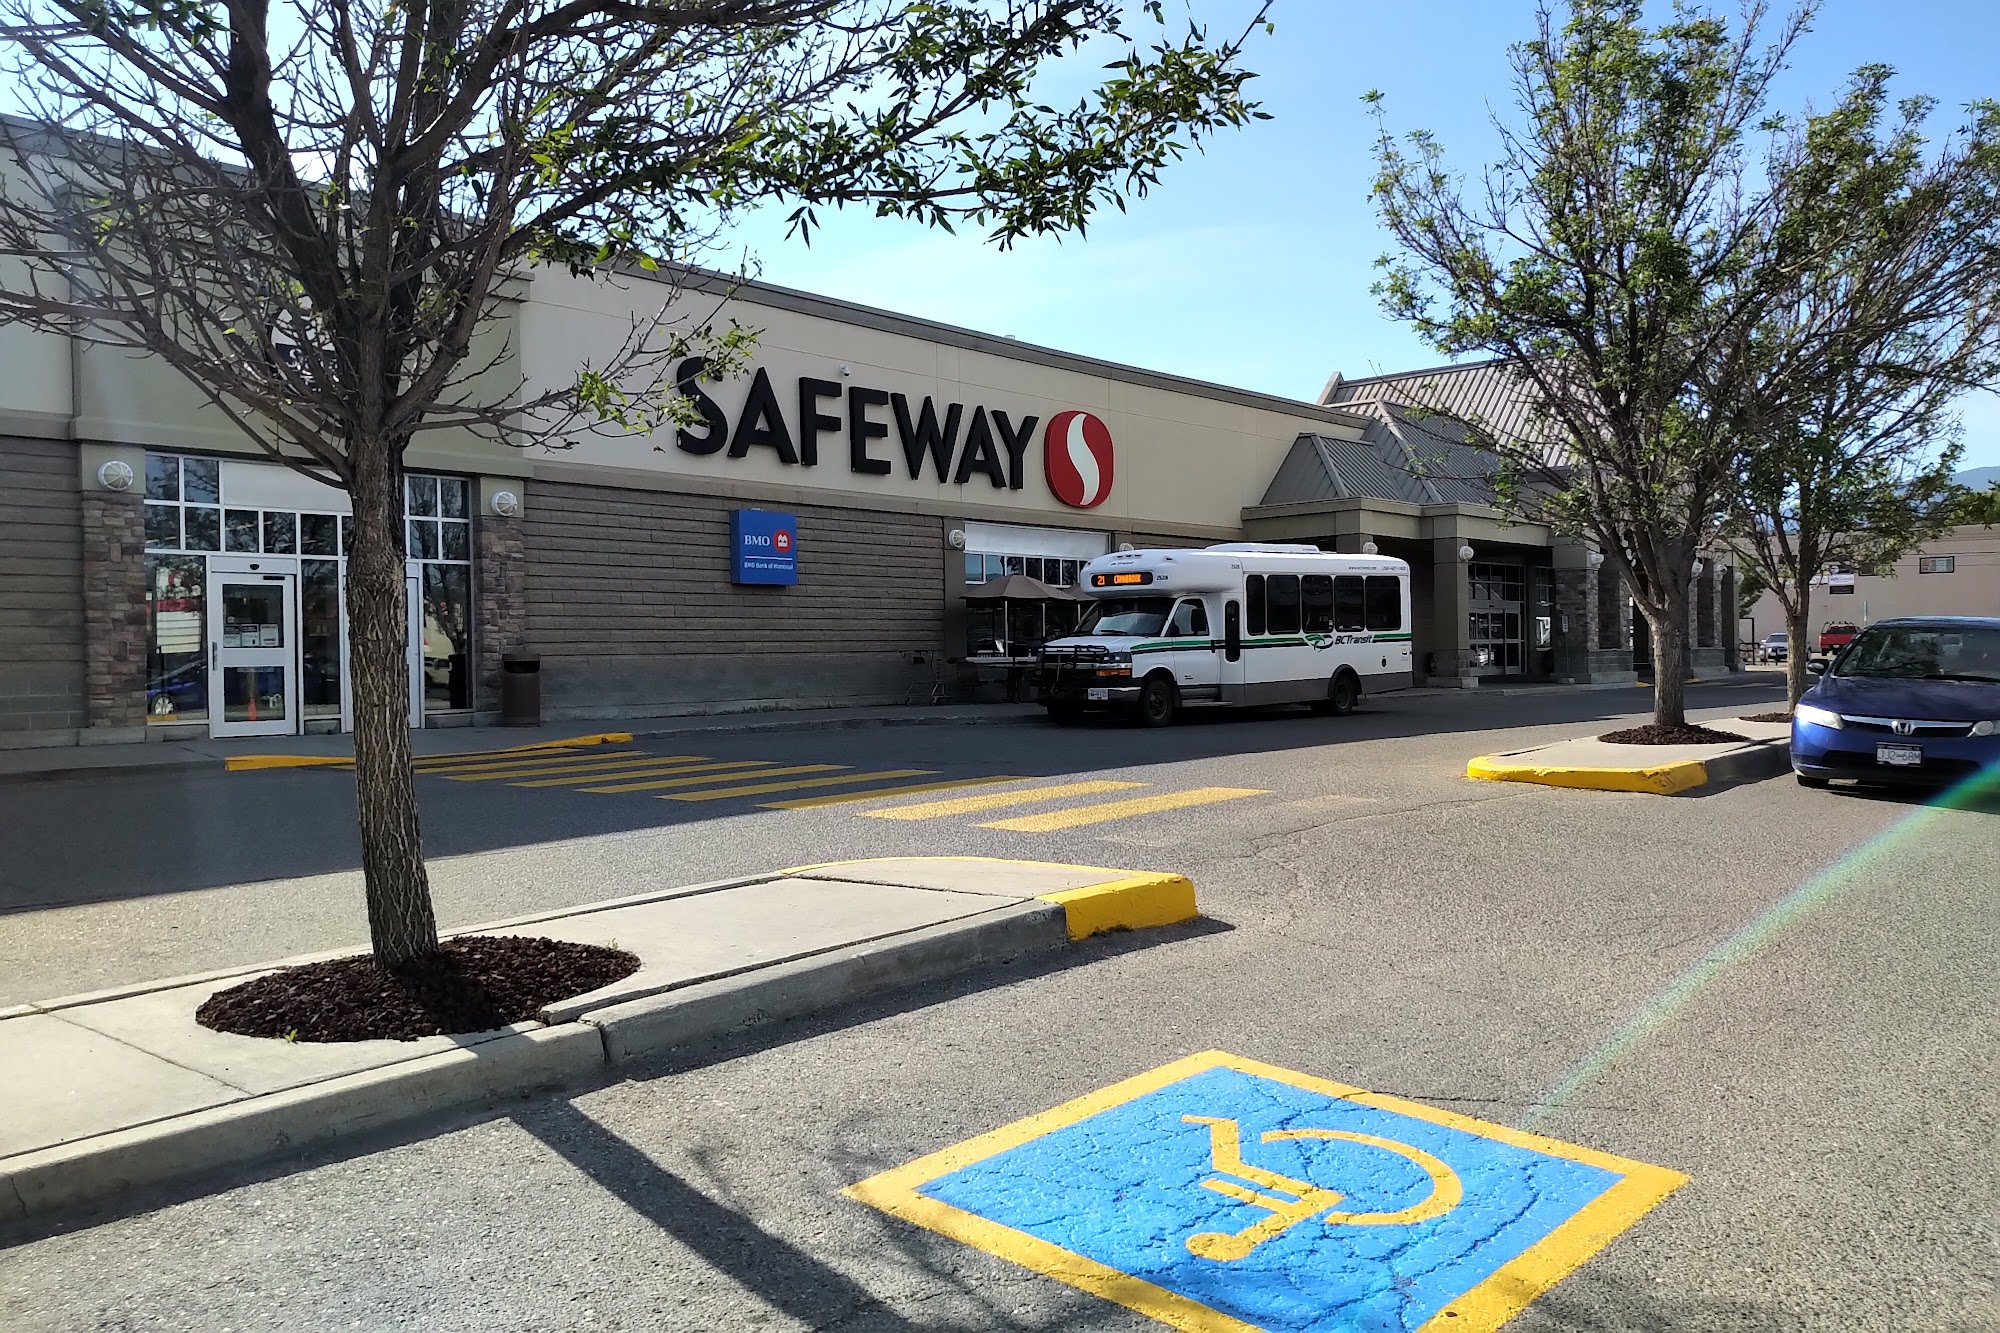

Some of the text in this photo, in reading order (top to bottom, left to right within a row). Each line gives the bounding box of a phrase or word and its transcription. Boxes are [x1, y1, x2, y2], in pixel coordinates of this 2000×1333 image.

[677, 356, 1040, 490] SAFEWAY
[744, 534, 771, 546] BMO
[1097, 575, 1105, 585] 21
